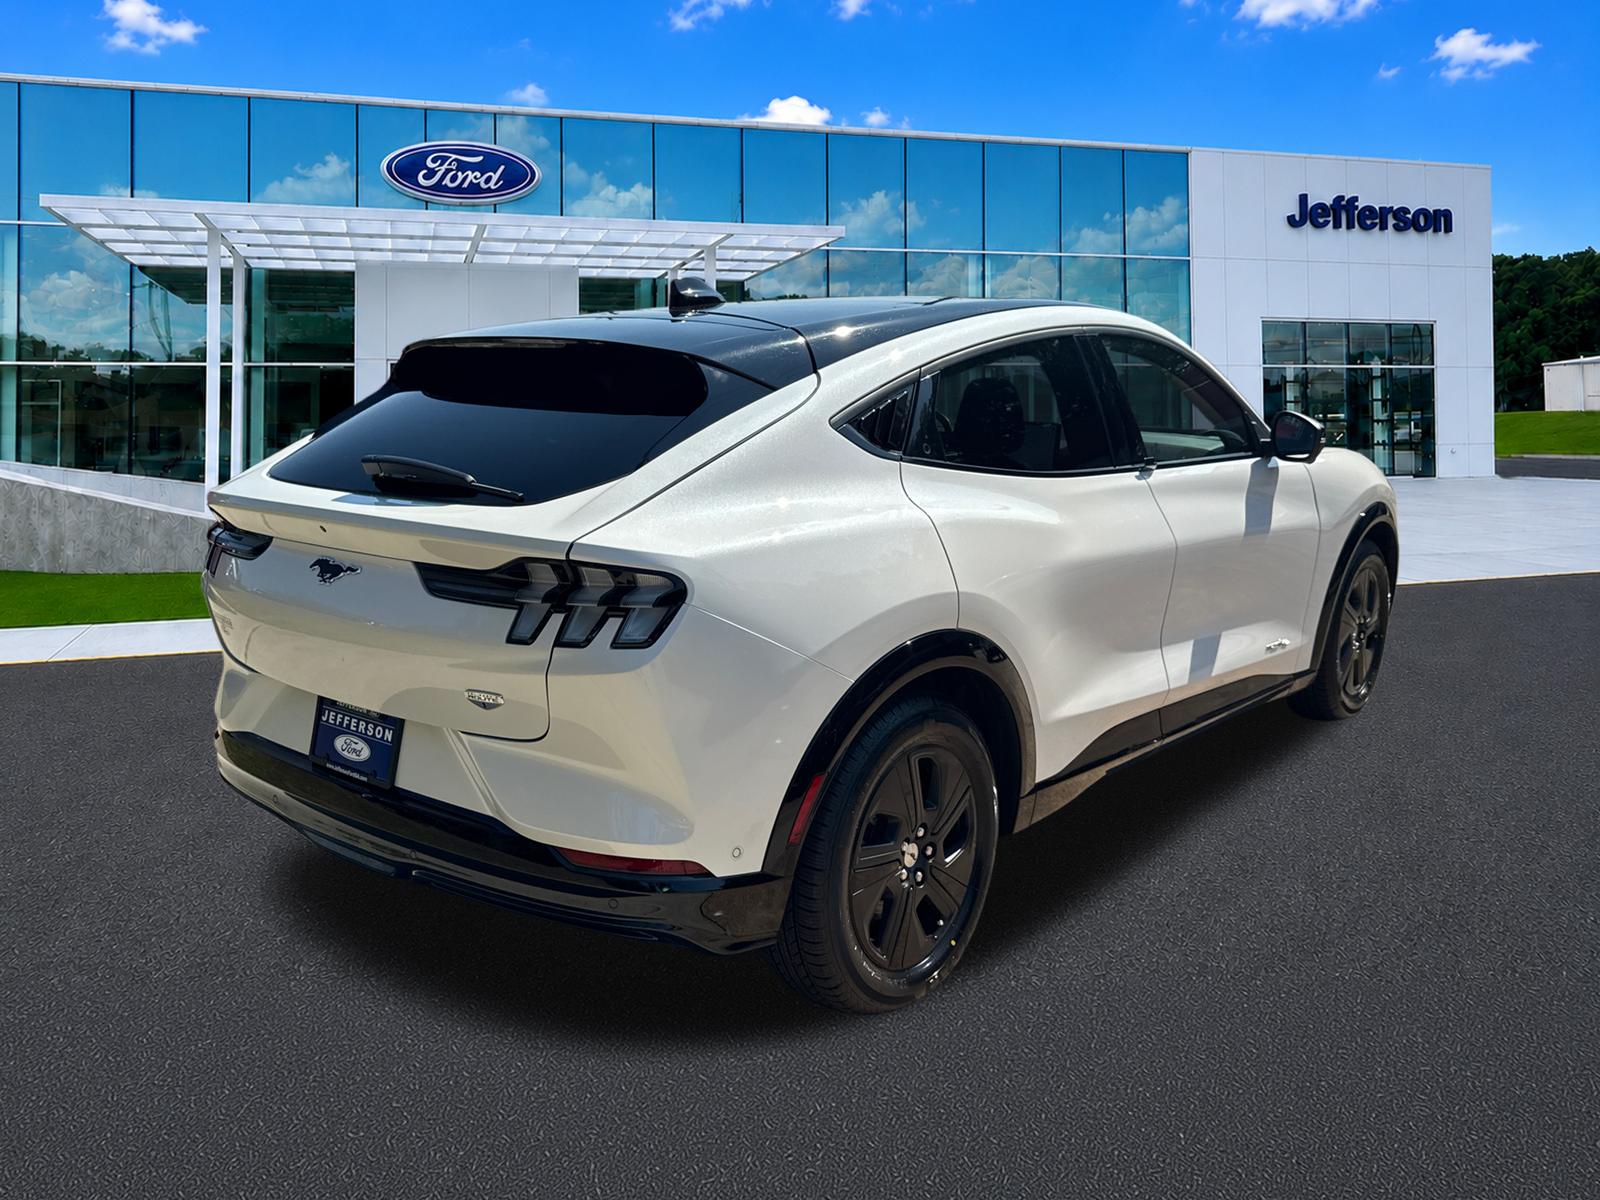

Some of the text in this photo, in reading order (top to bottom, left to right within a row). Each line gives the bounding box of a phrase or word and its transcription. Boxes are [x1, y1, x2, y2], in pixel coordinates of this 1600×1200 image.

[417, 152, 505, 189] Ford
[1286, 193, 1453, 233] Jefferson
[321, 710, 393, 742] JEFFERSON
[341, 738, 364, 757] Ford
